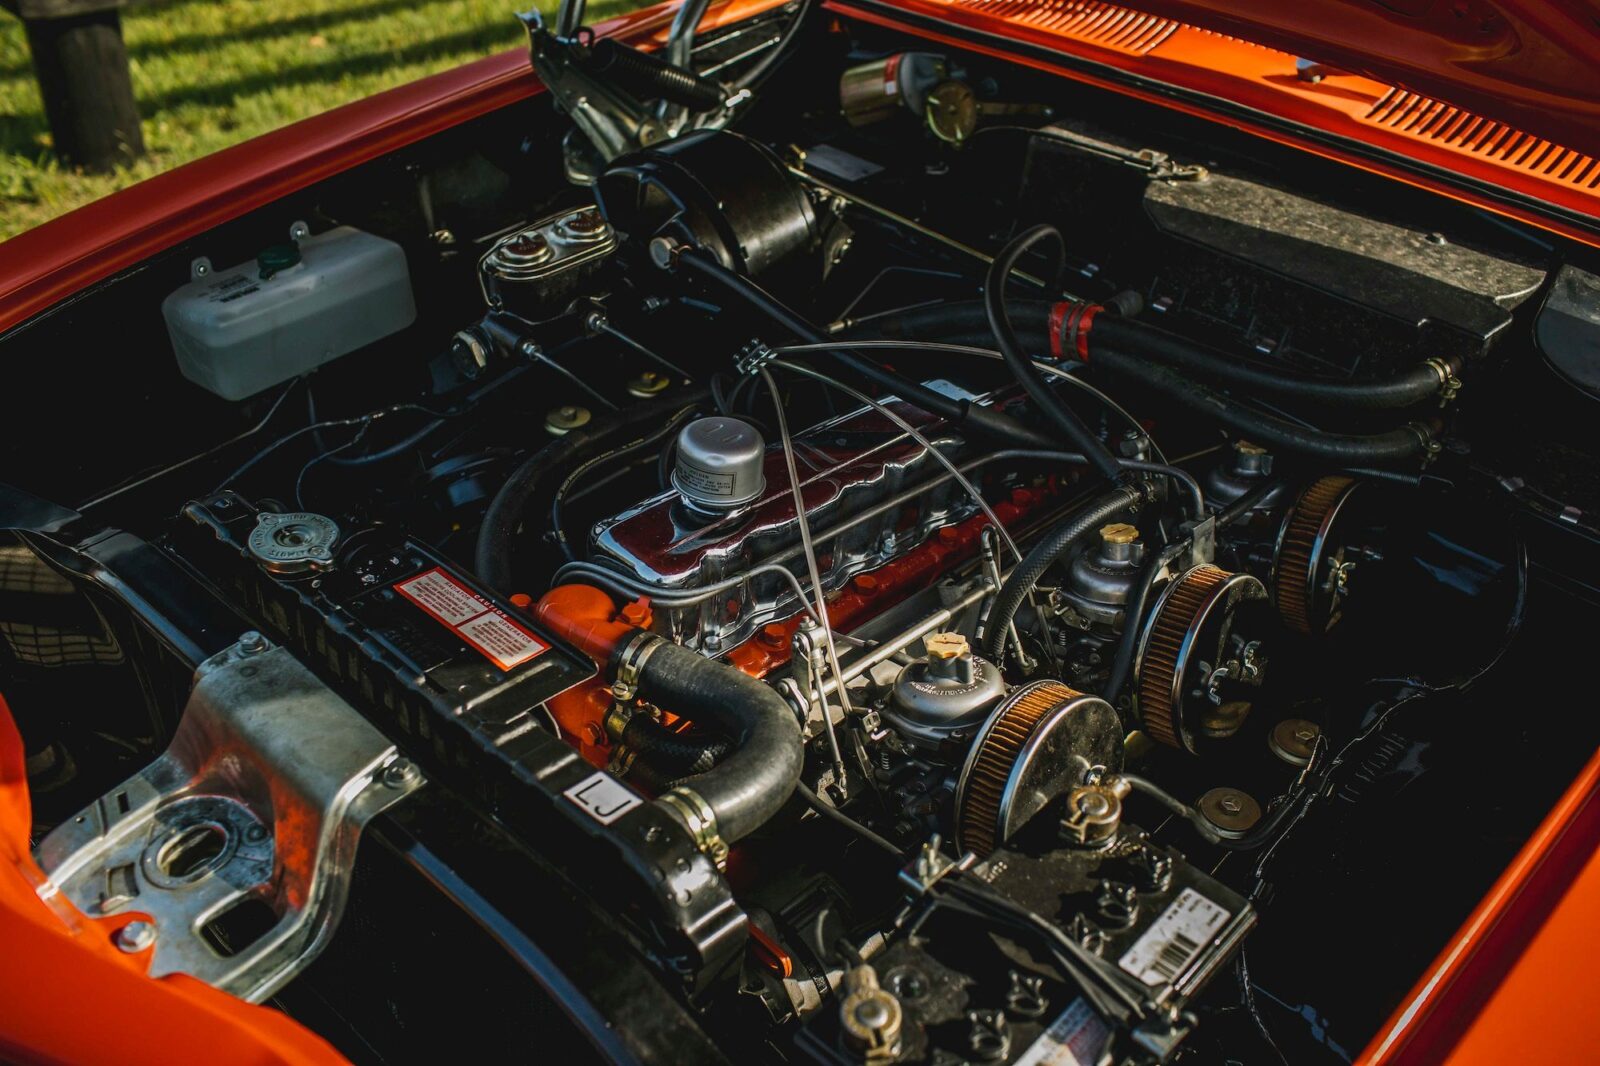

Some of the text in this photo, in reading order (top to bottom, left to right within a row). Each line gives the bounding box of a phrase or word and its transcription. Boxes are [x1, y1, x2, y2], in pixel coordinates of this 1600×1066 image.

[444, 581, 471, 600] RADIATOR
[474, 594, 508, 619] CAUTION
[498, 620, 532, 644] GENERATOR
[575, 778, 632, 817] LJ
